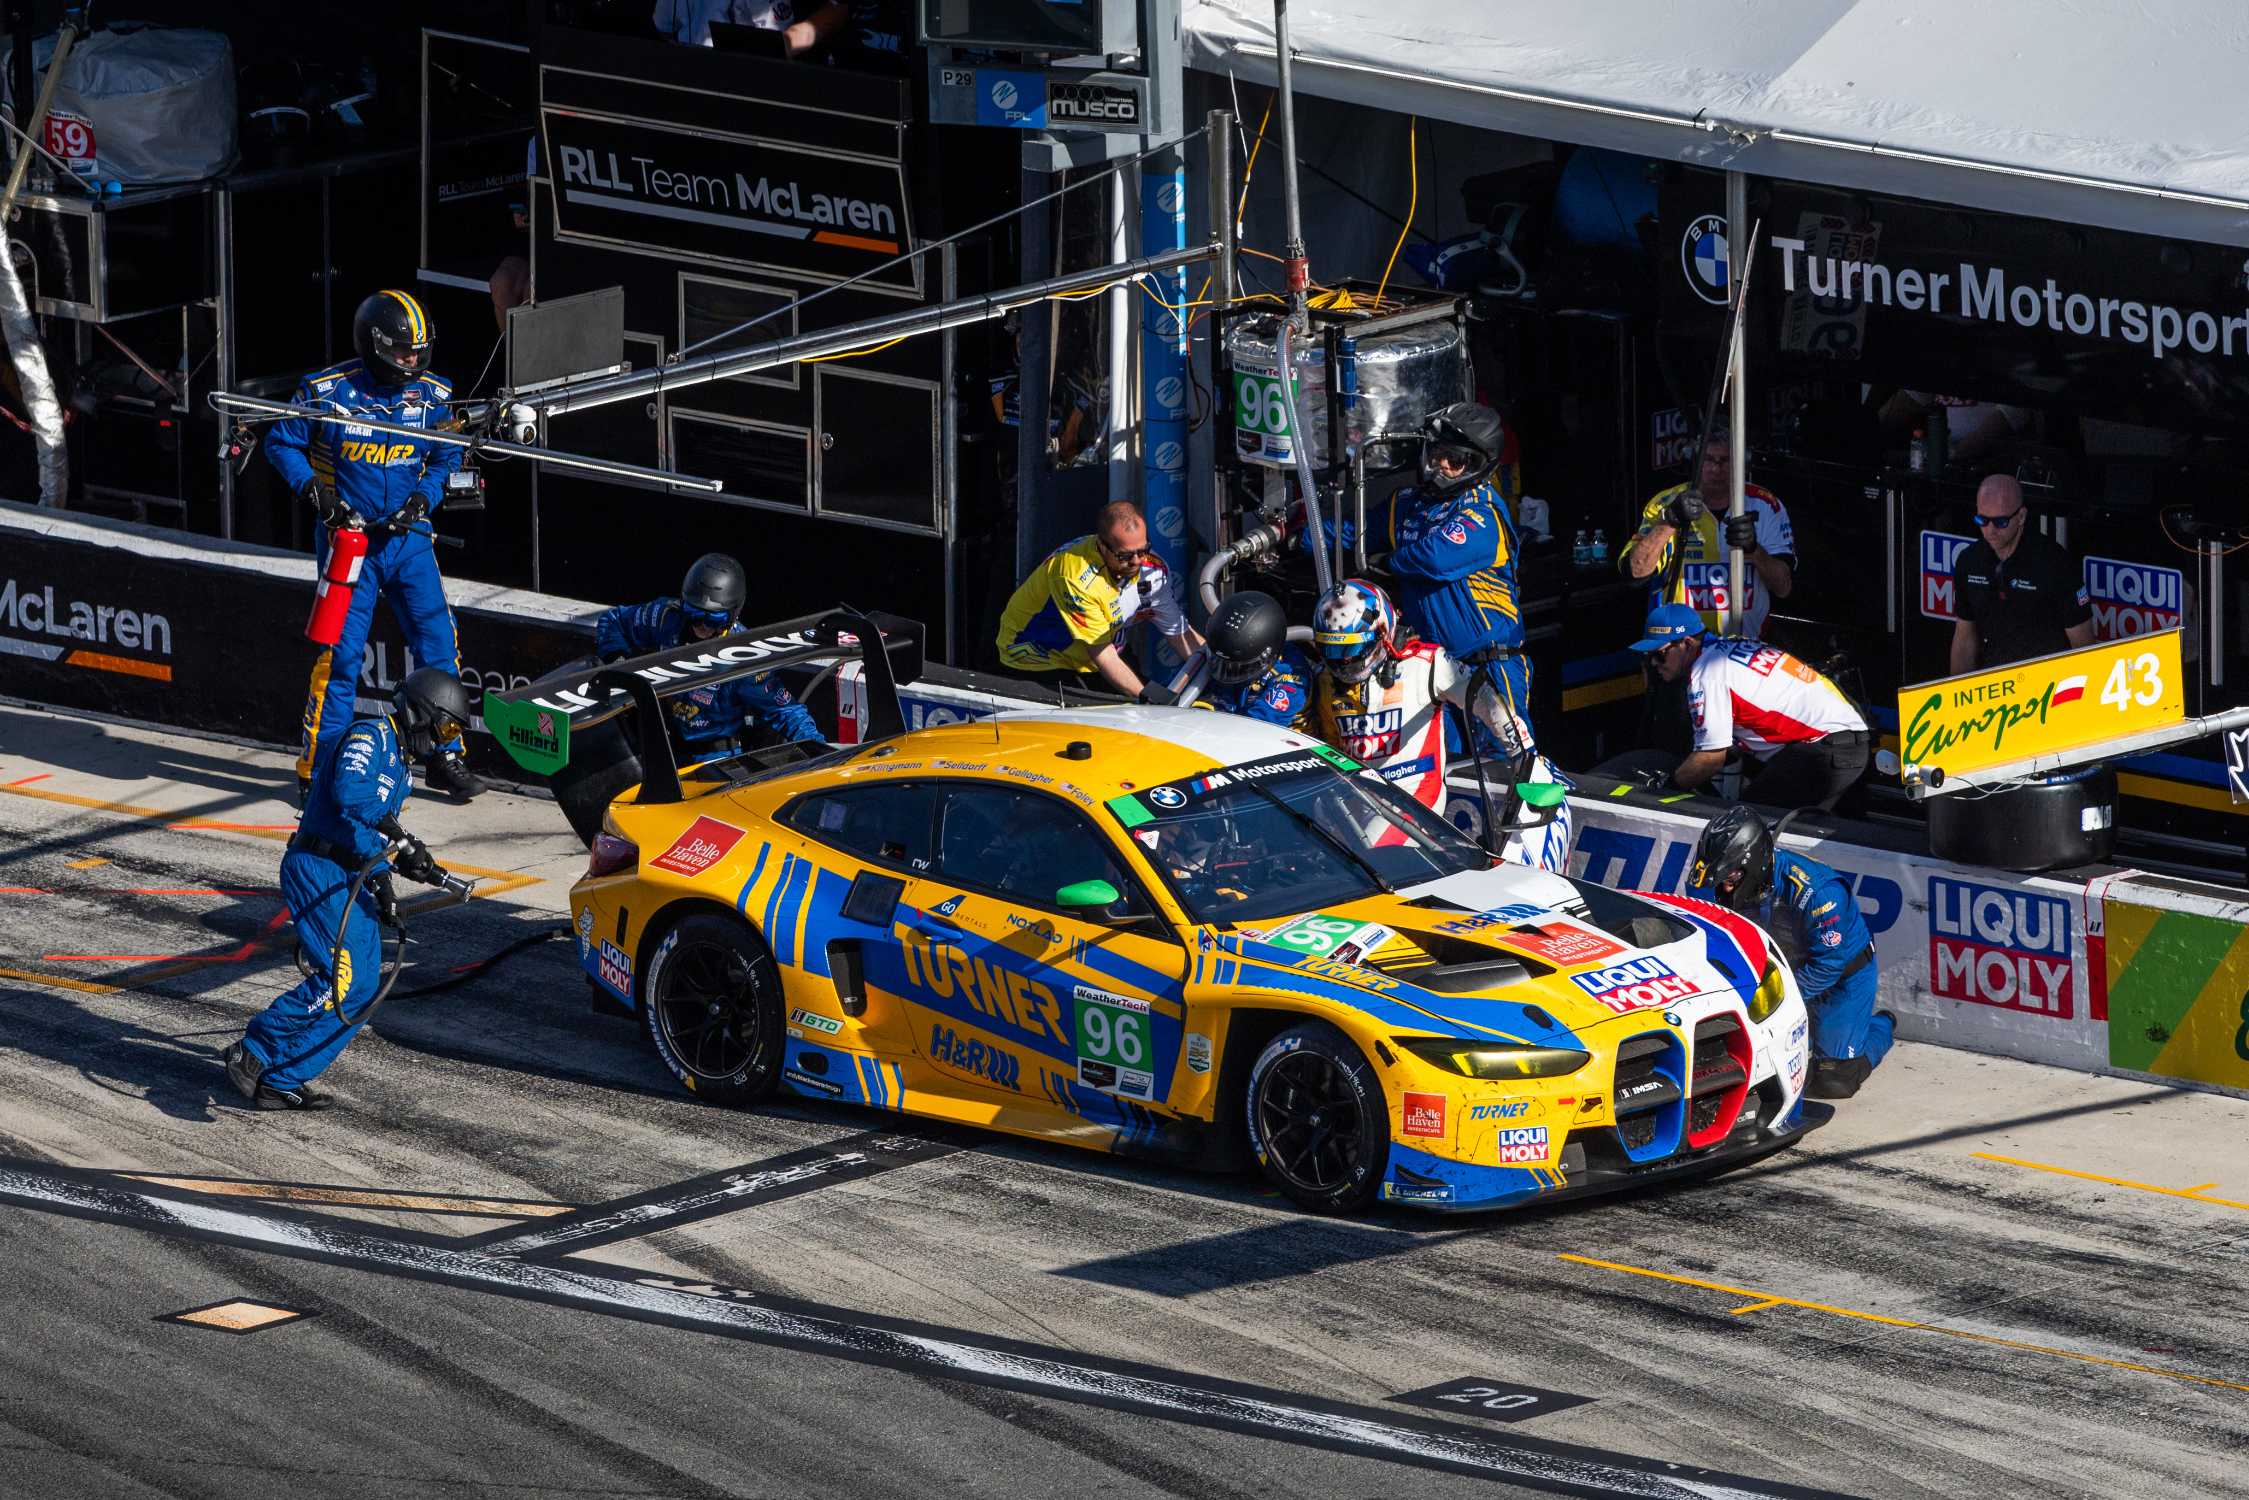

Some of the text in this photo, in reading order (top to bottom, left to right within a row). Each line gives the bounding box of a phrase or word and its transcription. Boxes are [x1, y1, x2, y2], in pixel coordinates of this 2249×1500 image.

[943, 71, 972, 86] P 29
[1005, 110, 1032, 121] FPL
[51, 121, 88, 157] 59
[560, 145, 897, 235] RLL Team McLaren
[1770, 235, 1950, 313] Turner
[1241, 377, 1288, 434] 96
[339, 440, 416, 465] TURNER
[2090, 562, 2177, 609] LIQUI
[1675, 625, 1686, 633] 96
[1953, 679, 2016, 708] INTER
[2099, 652, 2164, 713] 43
[1903, 681, 2056, 766] Europol
[508, 724, 560, 753] Hilliard
[1008, 767, 1055, 785] Gallagher
[1229, 757, 1326, 782] Motorsport
[668, 845, 710, 868] Haven
[687, 837, 720, 860] Belle
[941, 901, 956, 914] GO
[1934, 879, 2067, 954] LIQUI
[1282, 918, 1355, 952] 96
[1542, 937, 1603, 958] Haven
[1544, 930, 1590, 949] Belle
[601, 939, 631, 975] LIQUI
[601, 959, 631, 995] MOLY
[894, 920, 1071, 1047] TURNER
[1293, 954, 1401, 992] TURNER
[1576, 956, 1671, 995] LIQUI
[1937, 945, 2071, 1014] MOLY
[1076, 987, 1148, 1013] WeatherTech
[1603, 977, 1693, 1013] MOLY
[804, 1015, 838, 1032] GTD
[1083, 1006, 1143, 1065] 96
[1632, 1080, 1663, 1095] IMSA
[1407, 1114, 1441, 1129] Haven
[1415, 1106, 1441, 1119] Belle
[1470, 1102, 1530, 1121] TURNER
[1500, 1126, 1548, 1146] LIQUI
[1500, 1142, 1549, 1163] MOLY
[1435, 1386, 1539, 1409] 20
